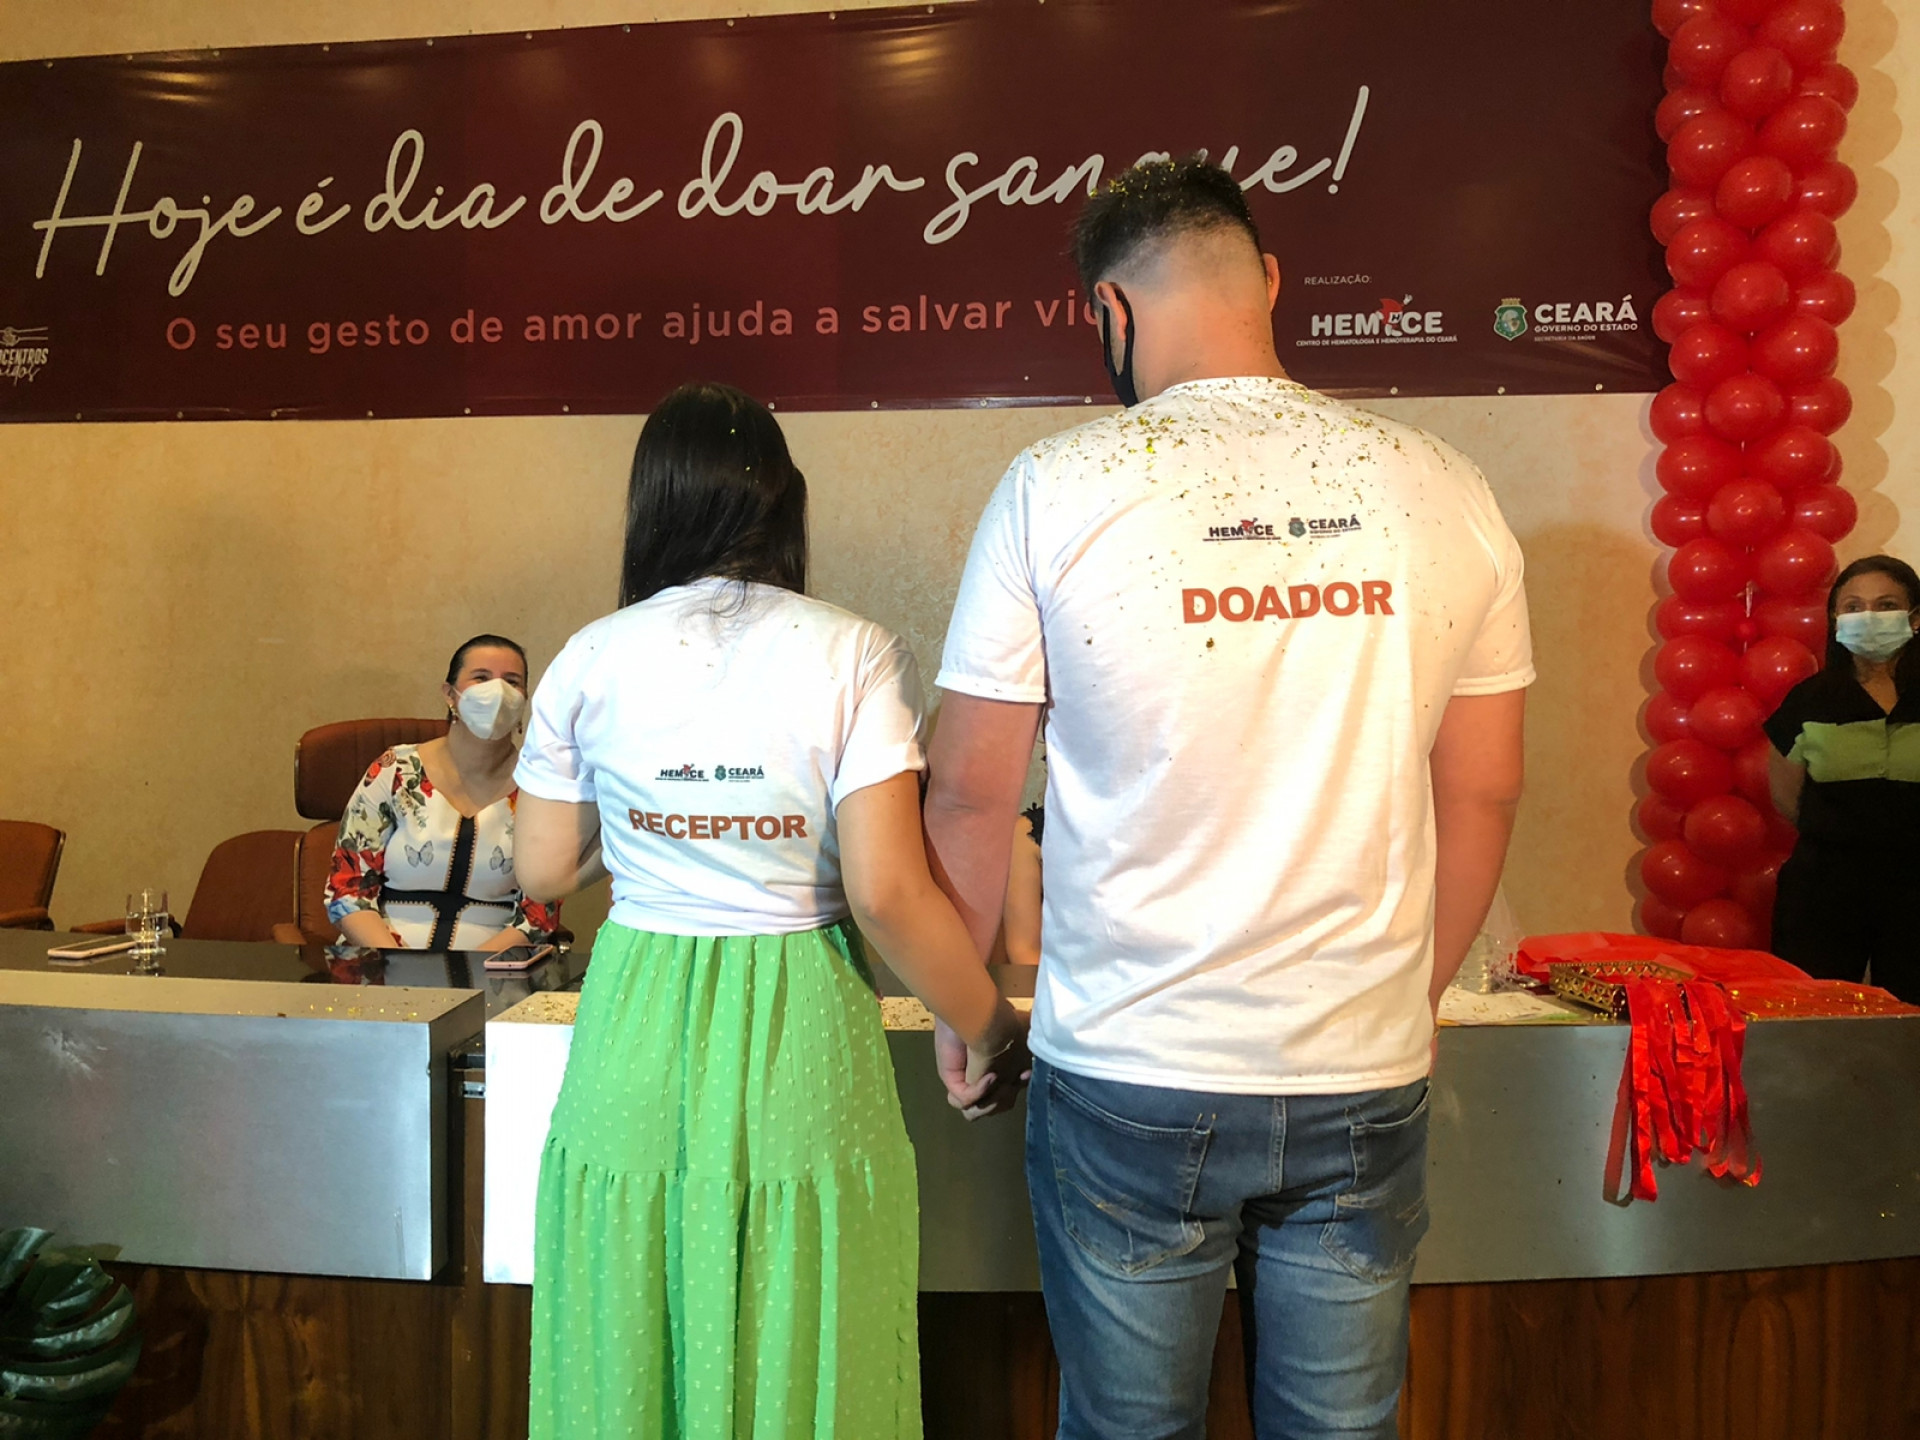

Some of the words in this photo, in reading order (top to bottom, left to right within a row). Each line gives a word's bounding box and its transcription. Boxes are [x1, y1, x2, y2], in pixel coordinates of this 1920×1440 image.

[33, 138, 283, 297] Hoje
[296, 176, 351, 235] é
[364, 129, 527, 231] dia
[539, 119, 664, 225] de
[677, 111, 926, 219] doar
[923, 85, 1370, 245] sane!
[1304, 274, 1373, 286] REALIZAÇÃO:
[167, 318, 196, 350] O
[217, 324, 286, 349] seu
[308, 314, 429, 354] gesto
[450, 309, 503, 343] de
[524, 313, 641, 342] amor
[663, 300, 793, 345] ajuda
[815, 306, 839, 335] a
[861, 294, 1012, 333] salvar
[1534, 293, 1639, 324] CEARÁ
[1534, 324, 1581, 333] GOVERNO
[1583, 323, 1598, 332] DO
[1600, 322, 1639, 332] ESTADO
[1308, 514, 1362, 529] CEARÁ
[1181, 579, 1396, 624] DOADOR
[728, 765, 765, 777] CEARÁ
[628, 807, 809, 841] RECEPTOR
